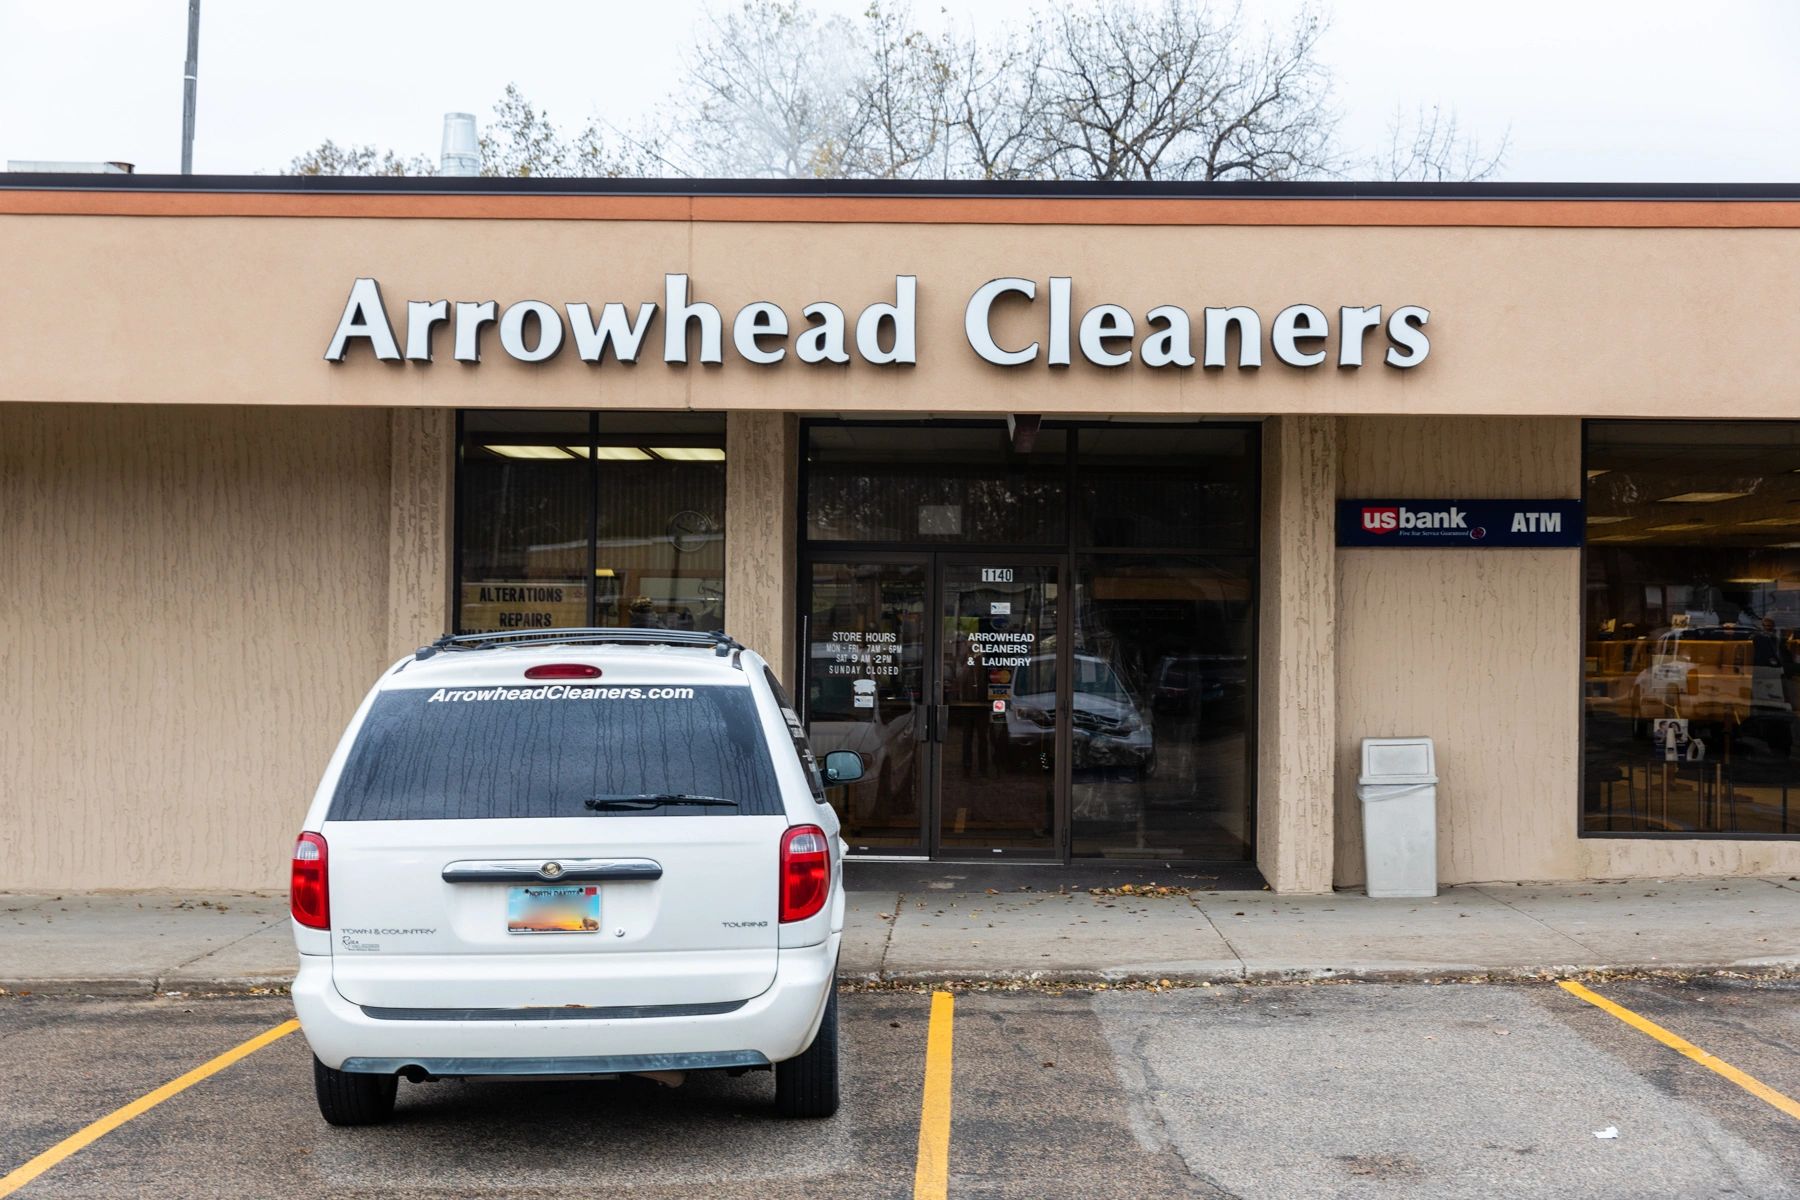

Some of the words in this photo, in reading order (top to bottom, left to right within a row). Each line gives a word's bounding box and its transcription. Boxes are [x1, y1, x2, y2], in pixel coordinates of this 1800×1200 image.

[323, 273, 917, 367] Arrowhead
[963, 276, 1431, 370] Cleaners
[1510, 512, 1562, 533] ATM
[982, 569, 1013, 582] 1140
[480, 587, 562, 602] ALTERATIONS
[499, 612, 552, 628] REPAIRS
[832, 632, 862, 642] STORE
[865, 632, 897, 643] HOURS
[967, 632, 1035, 643] ARROWHEAD
[826, 644, 840, 653] MON
[848, 644, 859, 653] FRI
[866, 644, 881, 653] 7AM
[971, 643, 1028, 654] CLEANERS
[836, 654, 848, 663] SAT
[851, 654, 858, 663] 9
[860, 654, 871, 663] AM
[967, 656, 975, 666] &
[981, 657, 1032, 667] LAUNDRY
[828, 665, 861, 675] SUNDAY
[865, 666, 899, 676] CLOSED
[428, 685, 694, 703] ArrowheadCleaners.com
